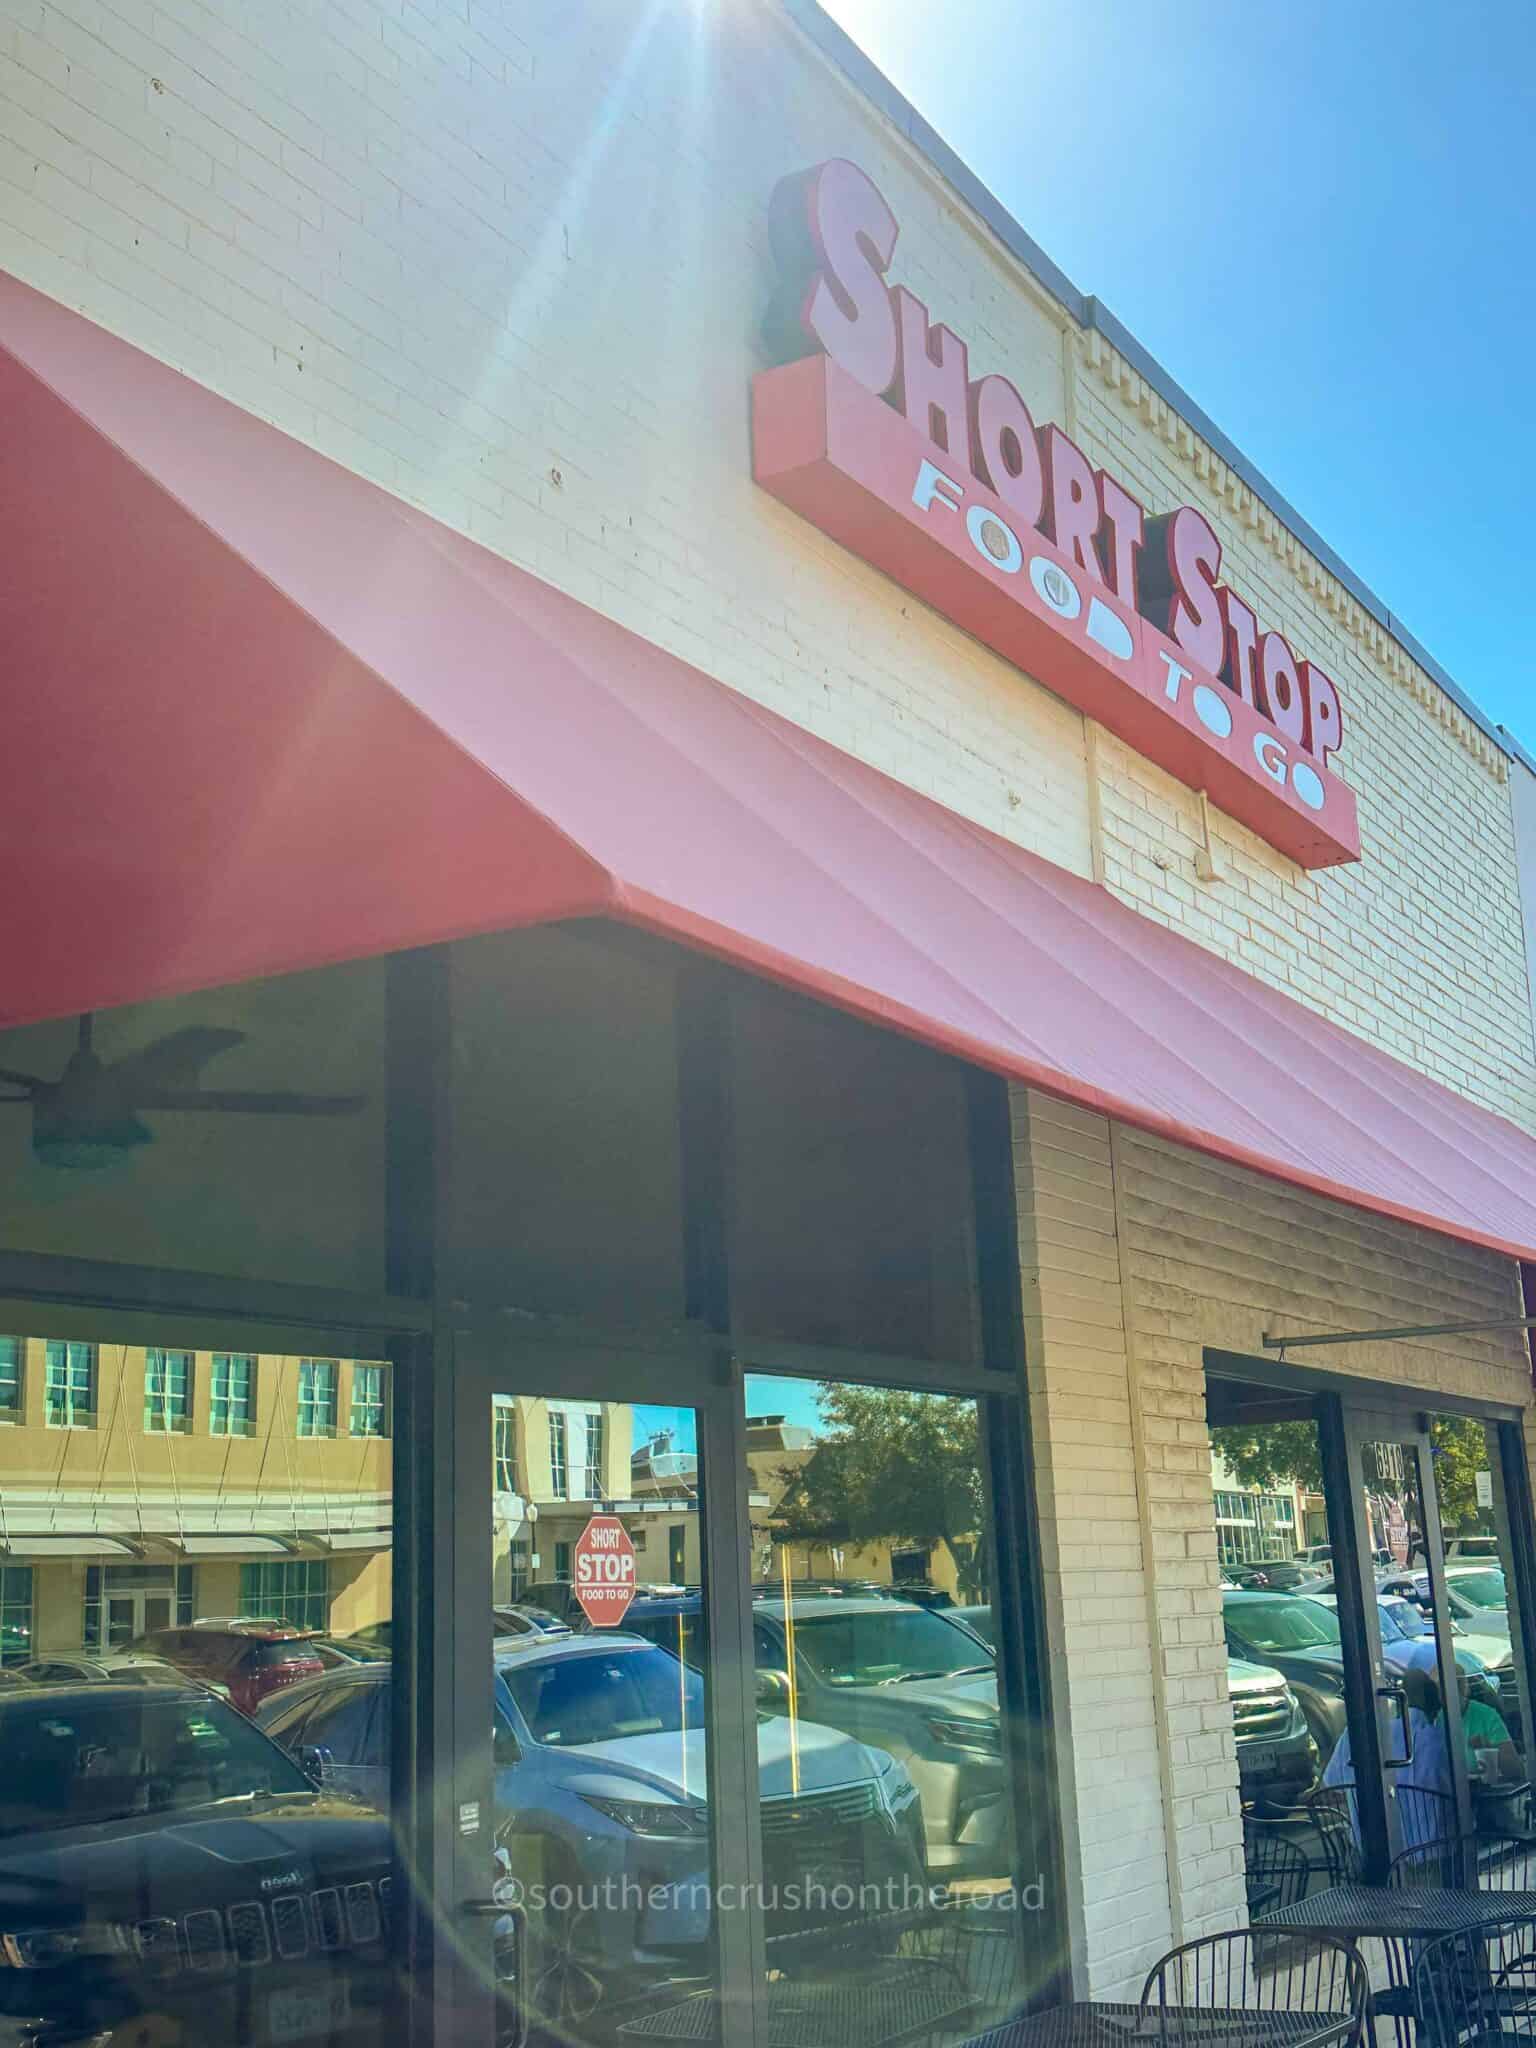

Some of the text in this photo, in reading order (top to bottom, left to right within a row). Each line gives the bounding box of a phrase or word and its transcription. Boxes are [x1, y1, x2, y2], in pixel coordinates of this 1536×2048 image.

[808, 157, 1342, 769] SHORT STOP
[912, 458, 1325, 810] FOOD TO GO
[591, 1528, 621, 1549] SHORT
[577, 1553, 634, 1582] STOP
[582, 1589, 629, 1601] FOOD TO GO
